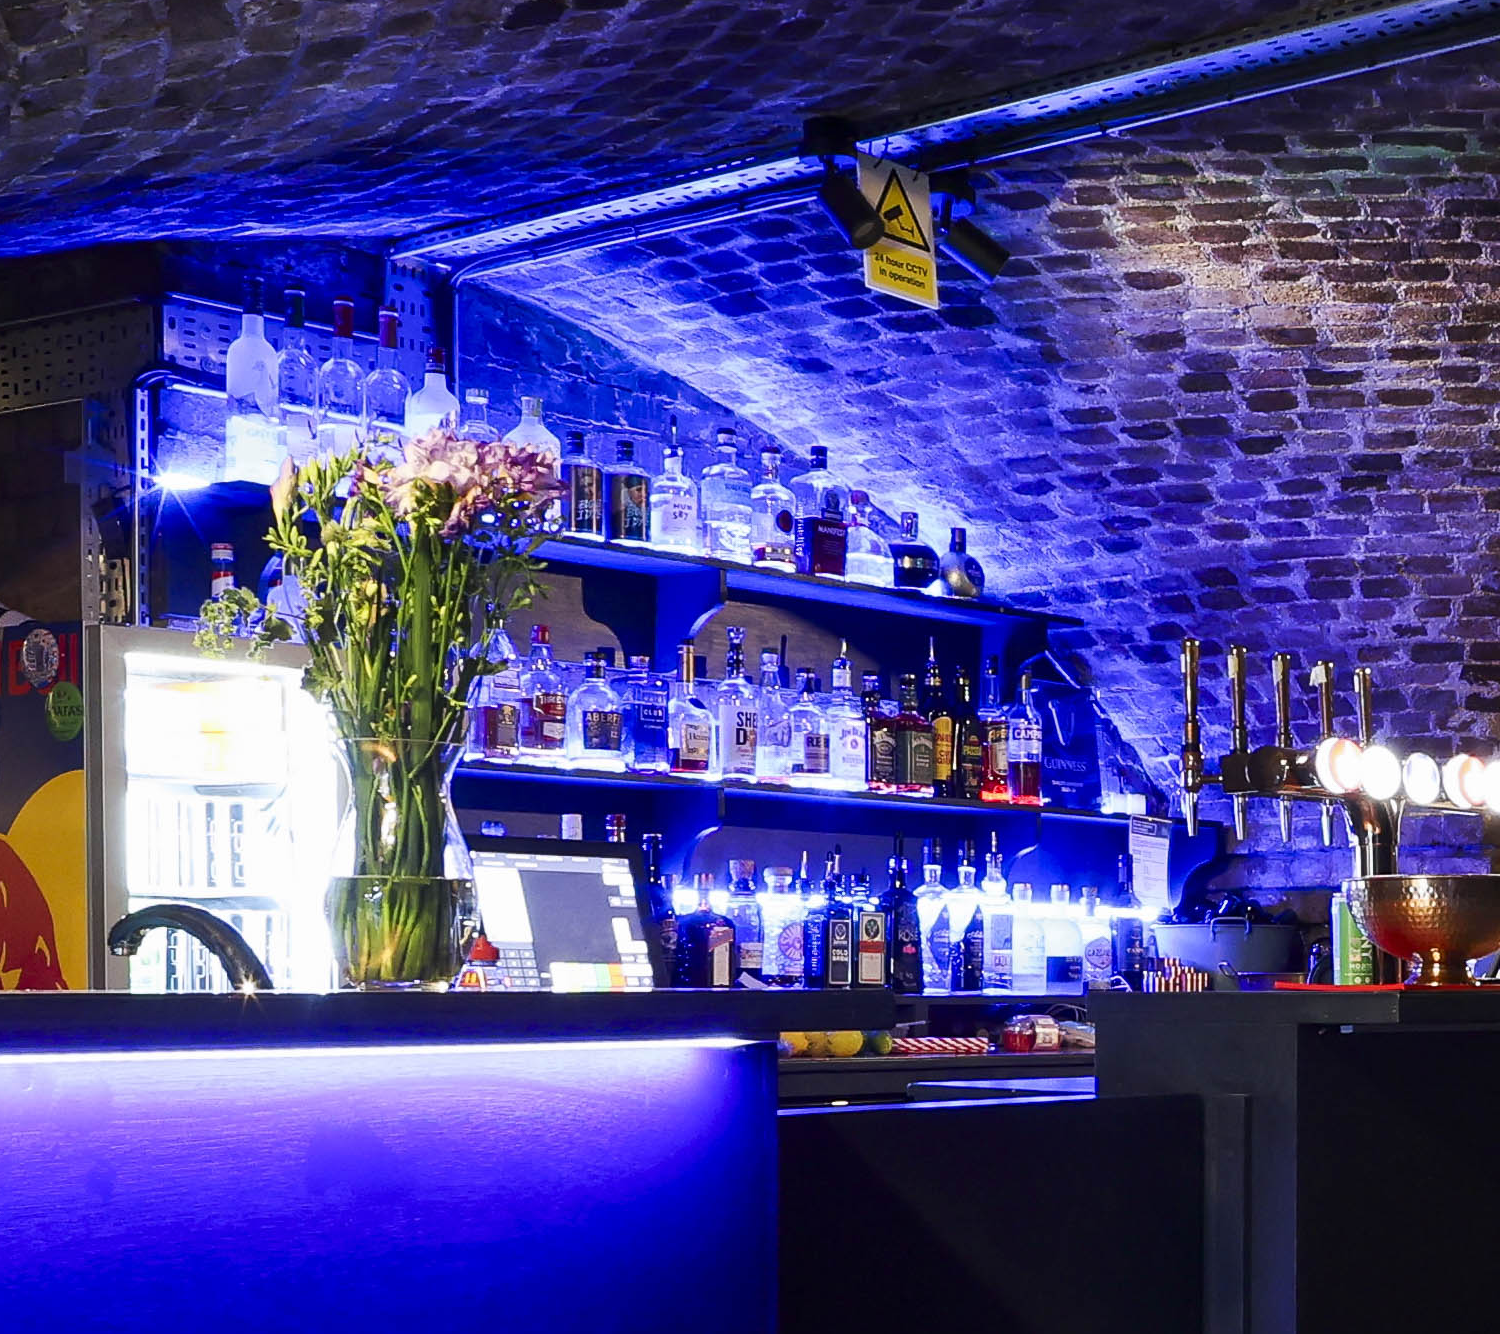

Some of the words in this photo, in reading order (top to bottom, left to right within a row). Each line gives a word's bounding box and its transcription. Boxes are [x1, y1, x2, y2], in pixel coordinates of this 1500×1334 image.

[885, 256, 904, 268] hour
[906, 263, 928, 277] CCTV
[888, 271, 926, 289] operation
[1043, 756, 1087, 772] GUINNESS
